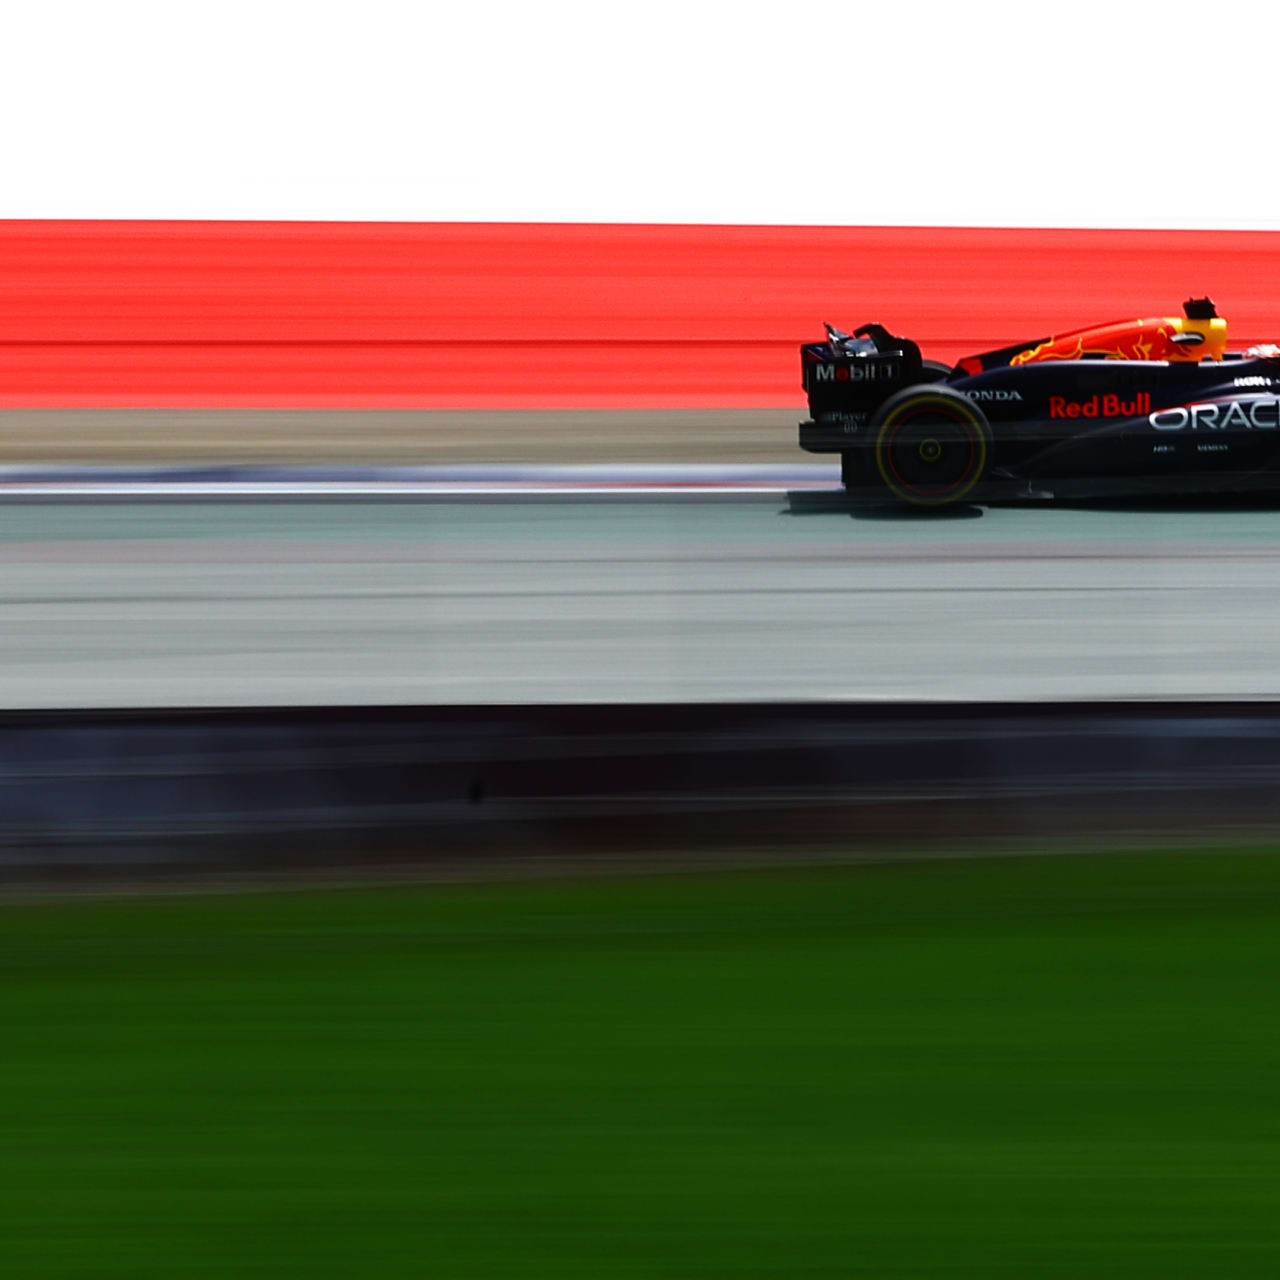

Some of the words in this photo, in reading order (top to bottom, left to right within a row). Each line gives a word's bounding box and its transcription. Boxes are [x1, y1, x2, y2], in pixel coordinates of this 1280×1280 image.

[816, 363, 876, 382] Mobil
[962, 389, 1024, 401] ONDA
[1050, 394, 1099, 419] Red
[1102, 391, 1151, 417] Bull
